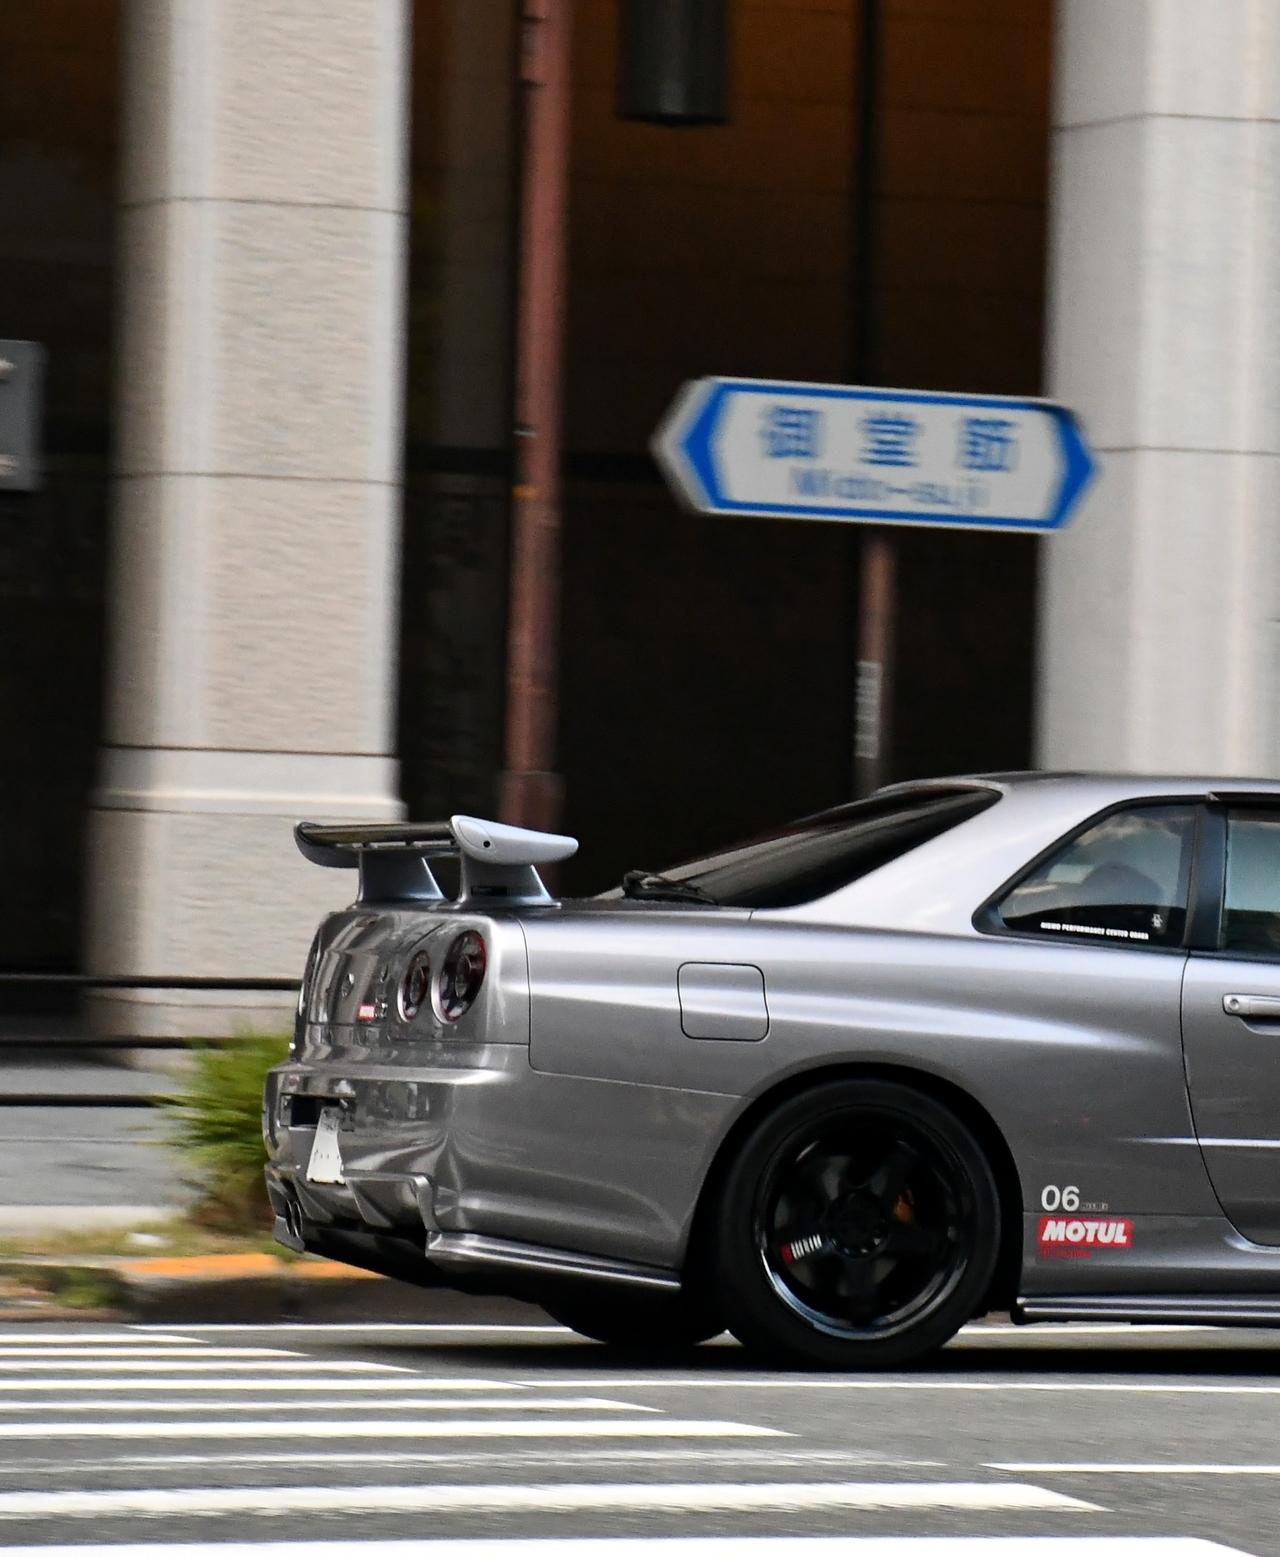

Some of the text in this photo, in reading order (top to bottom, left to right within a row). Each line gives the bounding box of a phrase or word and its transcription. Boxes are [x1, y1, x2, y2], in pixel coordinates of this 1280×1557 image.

[762, 404, 1018, 473] 御堂筋
[1041, 1184, 1080, 1212] 06
[1041, 1219, 1128, 1244] MOTUL
